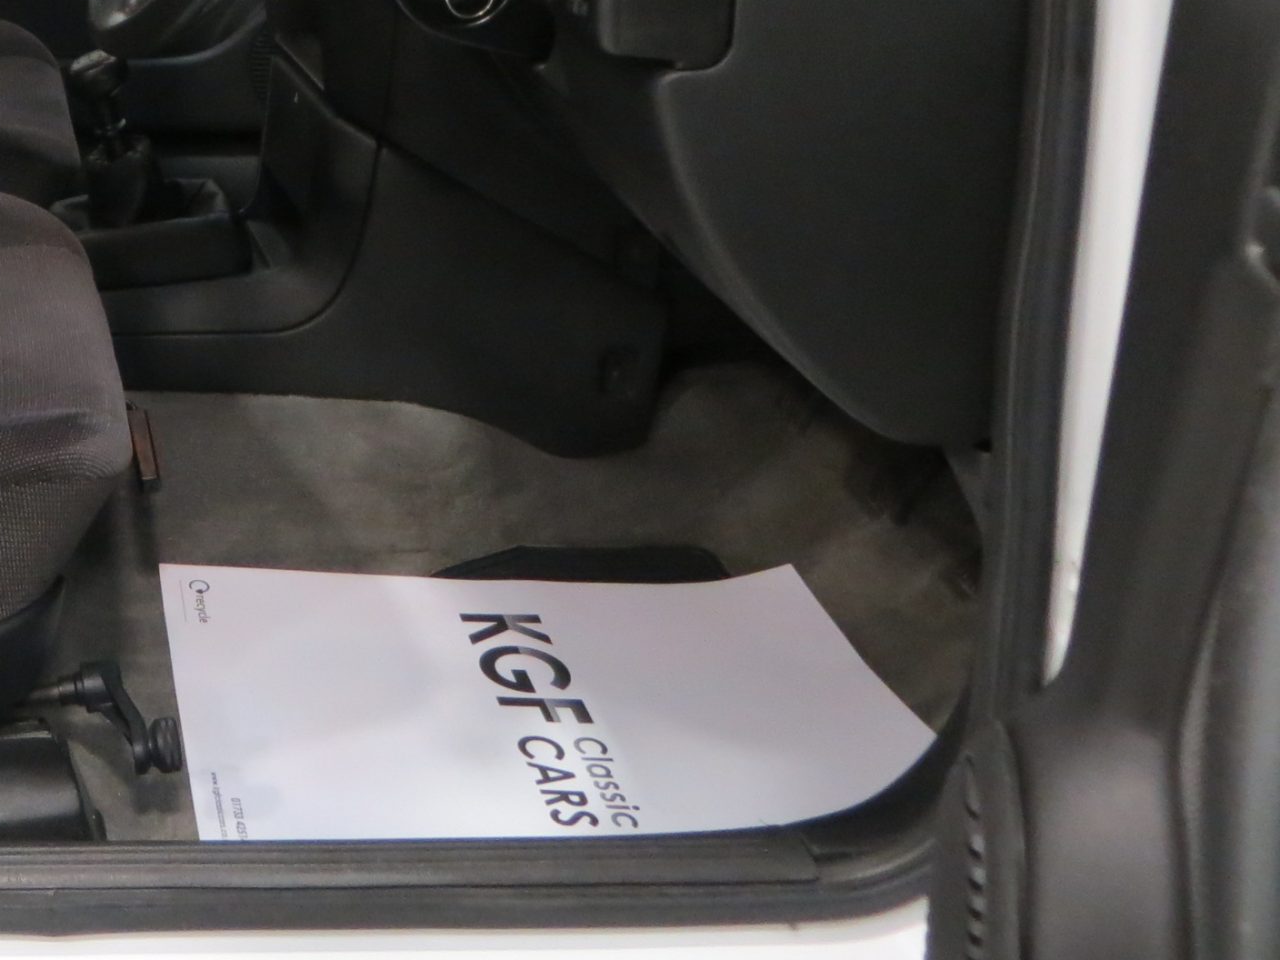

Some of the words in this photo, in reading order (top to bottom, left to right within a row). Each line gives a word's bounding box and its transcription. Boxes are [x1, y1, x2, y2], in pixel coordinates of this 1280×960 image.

[195, 594, 208, 623] recycle
[459, 613, 594, 724] KGF
[518, 736, 599, 827] CARS
[573, 737, 640, 828] Classic
